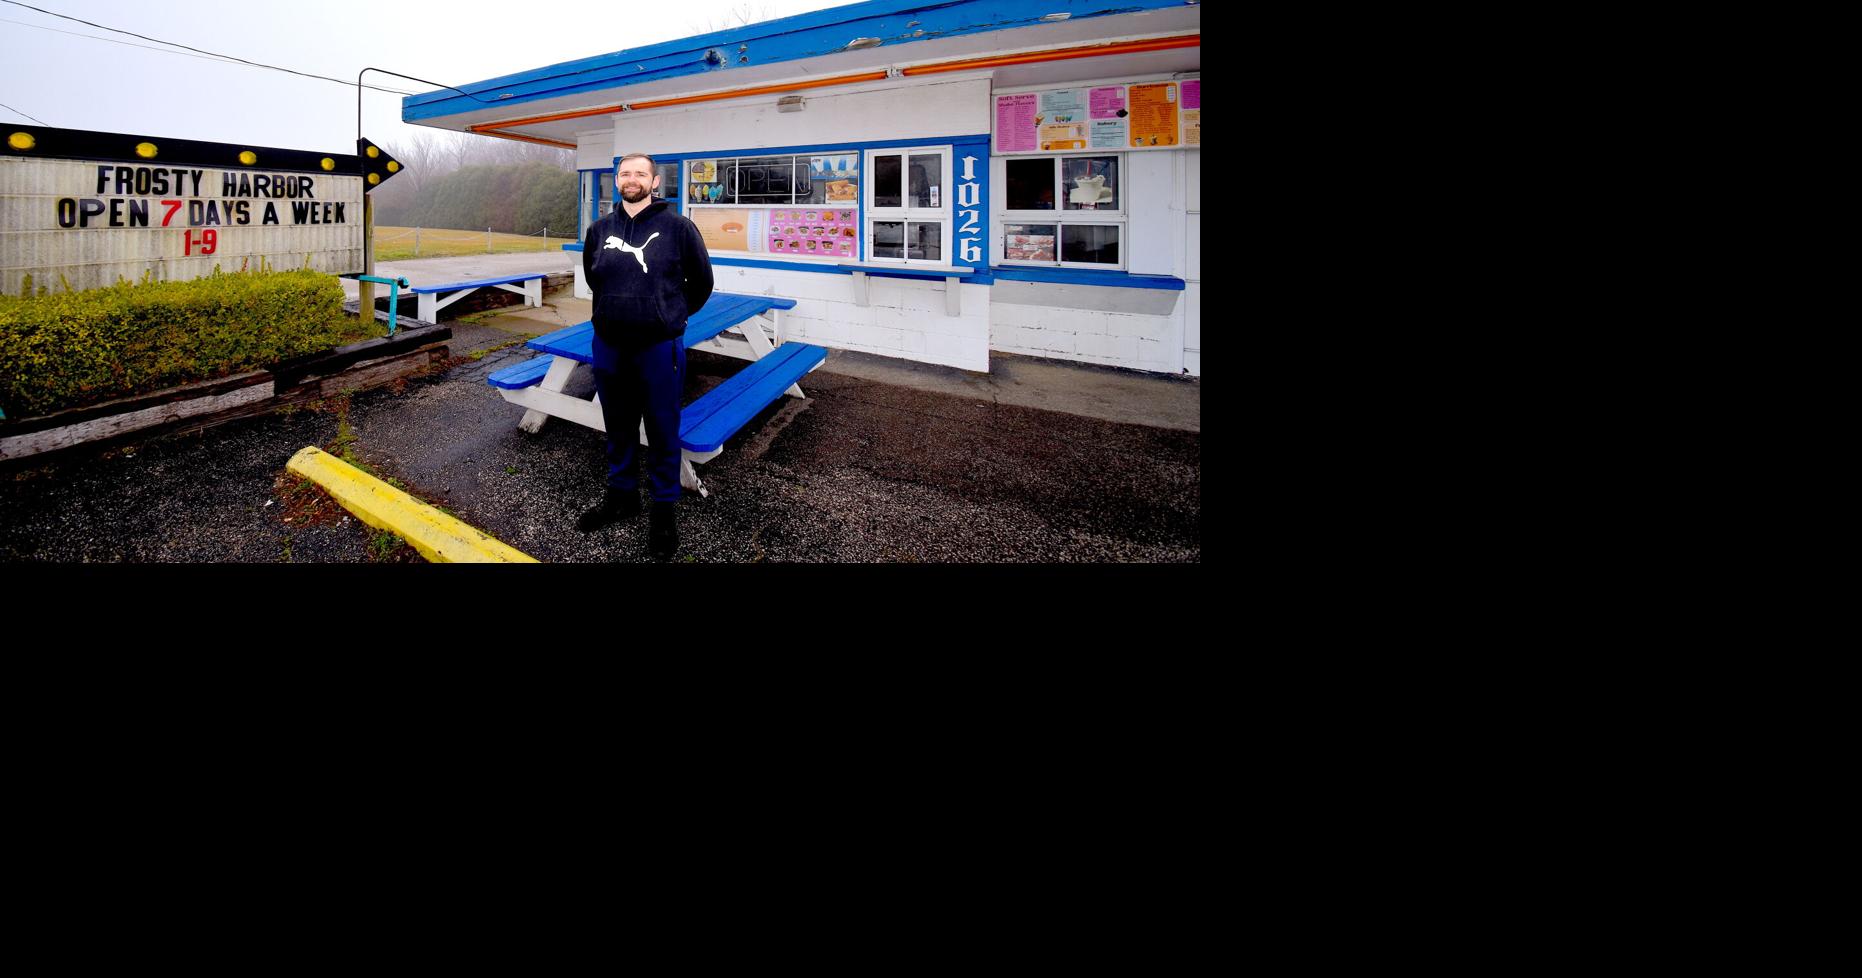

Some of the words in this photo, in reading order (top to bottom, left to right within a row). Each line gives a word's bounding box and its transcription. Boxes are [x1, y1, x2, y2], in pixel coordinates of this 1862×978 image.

[96, 165, 204, 197] FROSTY
[222, 172, 315, 199] HARBOR
[728, 167, 806, 193] OPEN
[57, 197, 149, 228] OPEN
[160, 200, 182, 227] 7
[189, 200, 250, 227] DAYS
[262, 201, 280, 225] A
[293, 201, 346, 225] WEEK
[957, 155, 982, 263] 1026
[183, 229, 218, 257] 1-9
